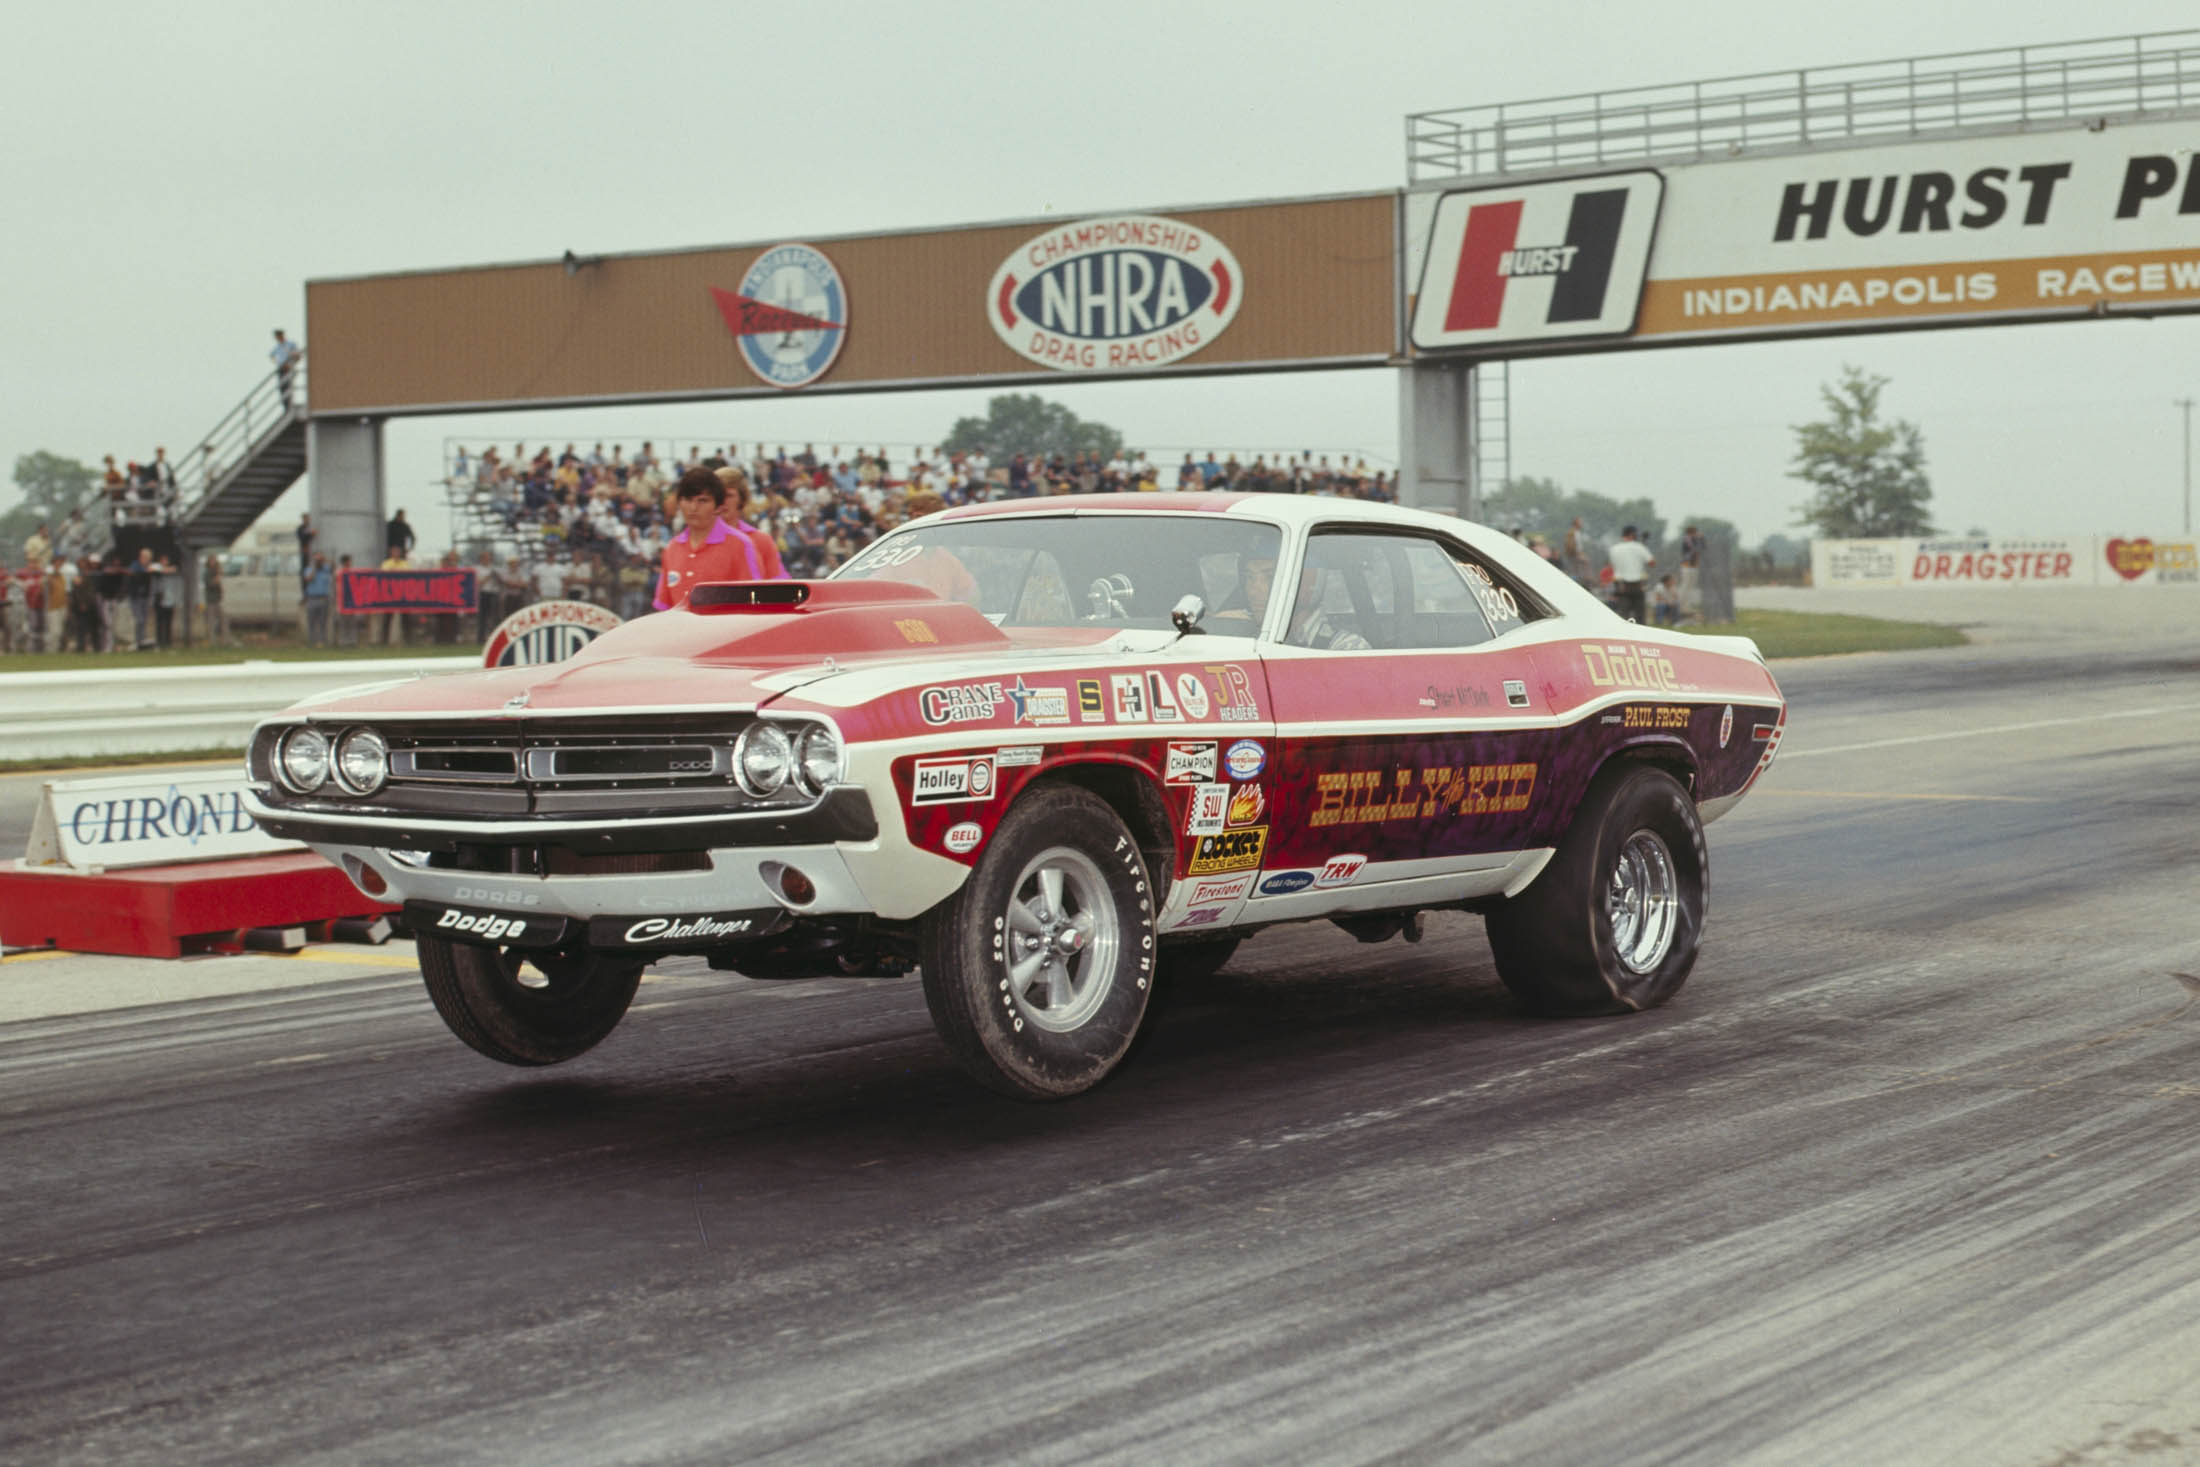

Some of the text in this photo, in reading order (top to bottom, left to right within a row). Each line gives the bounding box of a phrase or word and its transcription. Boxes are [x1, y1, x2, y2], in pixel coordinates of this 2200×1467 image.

[1772, 162, 2073, 242] HURST
[1028, 222, 1201, 267] CHAMPIONSHIP
[1497, 246, 1579, 276] HURST
[1042, 251, 1190, 337] NHRA
[1684, 261, 2200, 317] INDIANAPOLIS RACEW
[1029, 322, 1201, 368] DRAG RACING
[1912, 551, 2073, 581] DRAGSTER
[350, 573, 466, 606] VALVOLINE
[1581, 644, 1680, 692] Dodge
[1219, 706, 1260, 721] HEADERS
[1624, 706, 1653, 728] PAUL
[1655, 706, 1691, 728] FROST
[1171, 757, 1213, 770] CHAMPION
[920, 770, 965, 790] Holley
[1310, 768, 1452, 827] BILLY
[1459, 763, 1538, 815] KID
[1203, 794, 1222, 818] SW
[951, 830, 977, 841] BELL
[1321, 862, 1363, 880] TRW
[1195, 884, 1244, 901] Firestone
[437, 909, 527, 939] Dodge
[623, 916, 753, 943] Challenger
